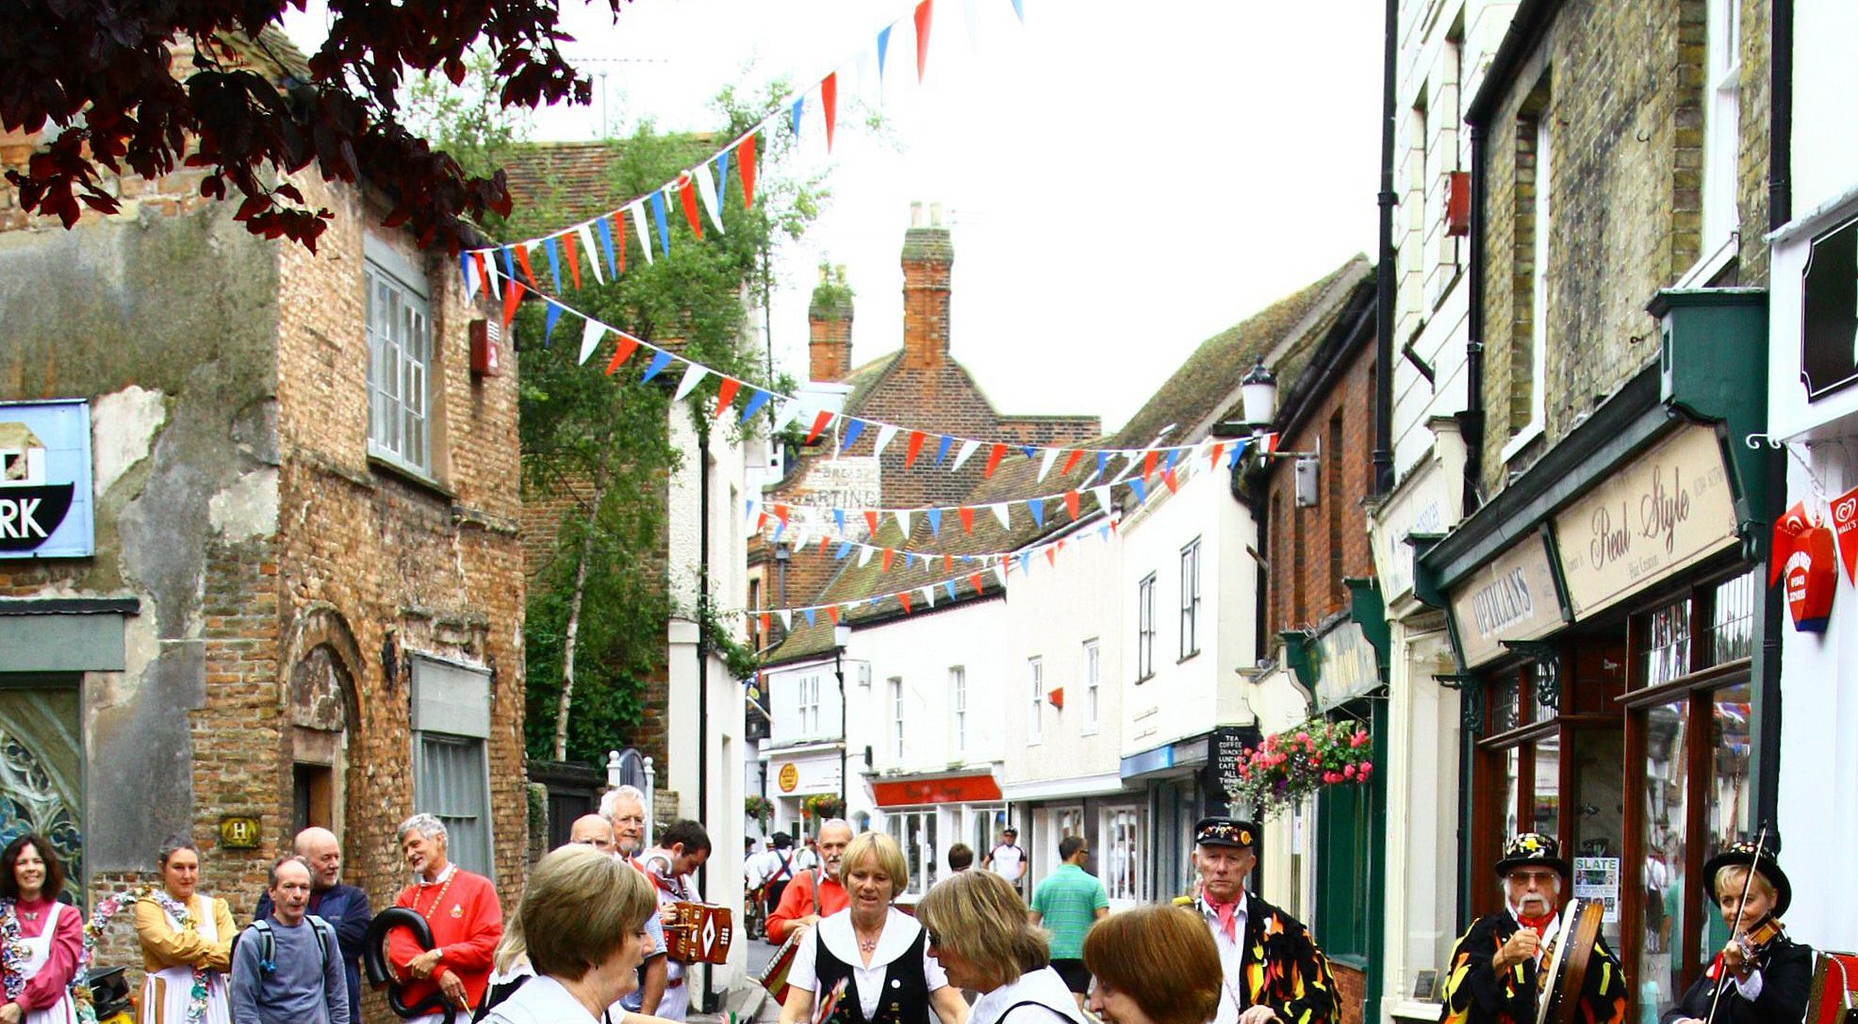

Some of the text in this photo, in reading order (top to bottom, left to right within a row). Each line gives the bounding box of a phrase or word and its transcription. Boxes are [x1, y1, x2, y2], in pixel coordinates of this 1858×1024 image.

[1590, 501, 1631, 571] Real
[1637, 464, 1690, 554] Style
[1472, 566, 1532, 636] OPTICIANS
[1224, 770, 1237, 778] ALL
[232, 822, 247, 840] H
[1575, 859, 1617, 870] SLATE
